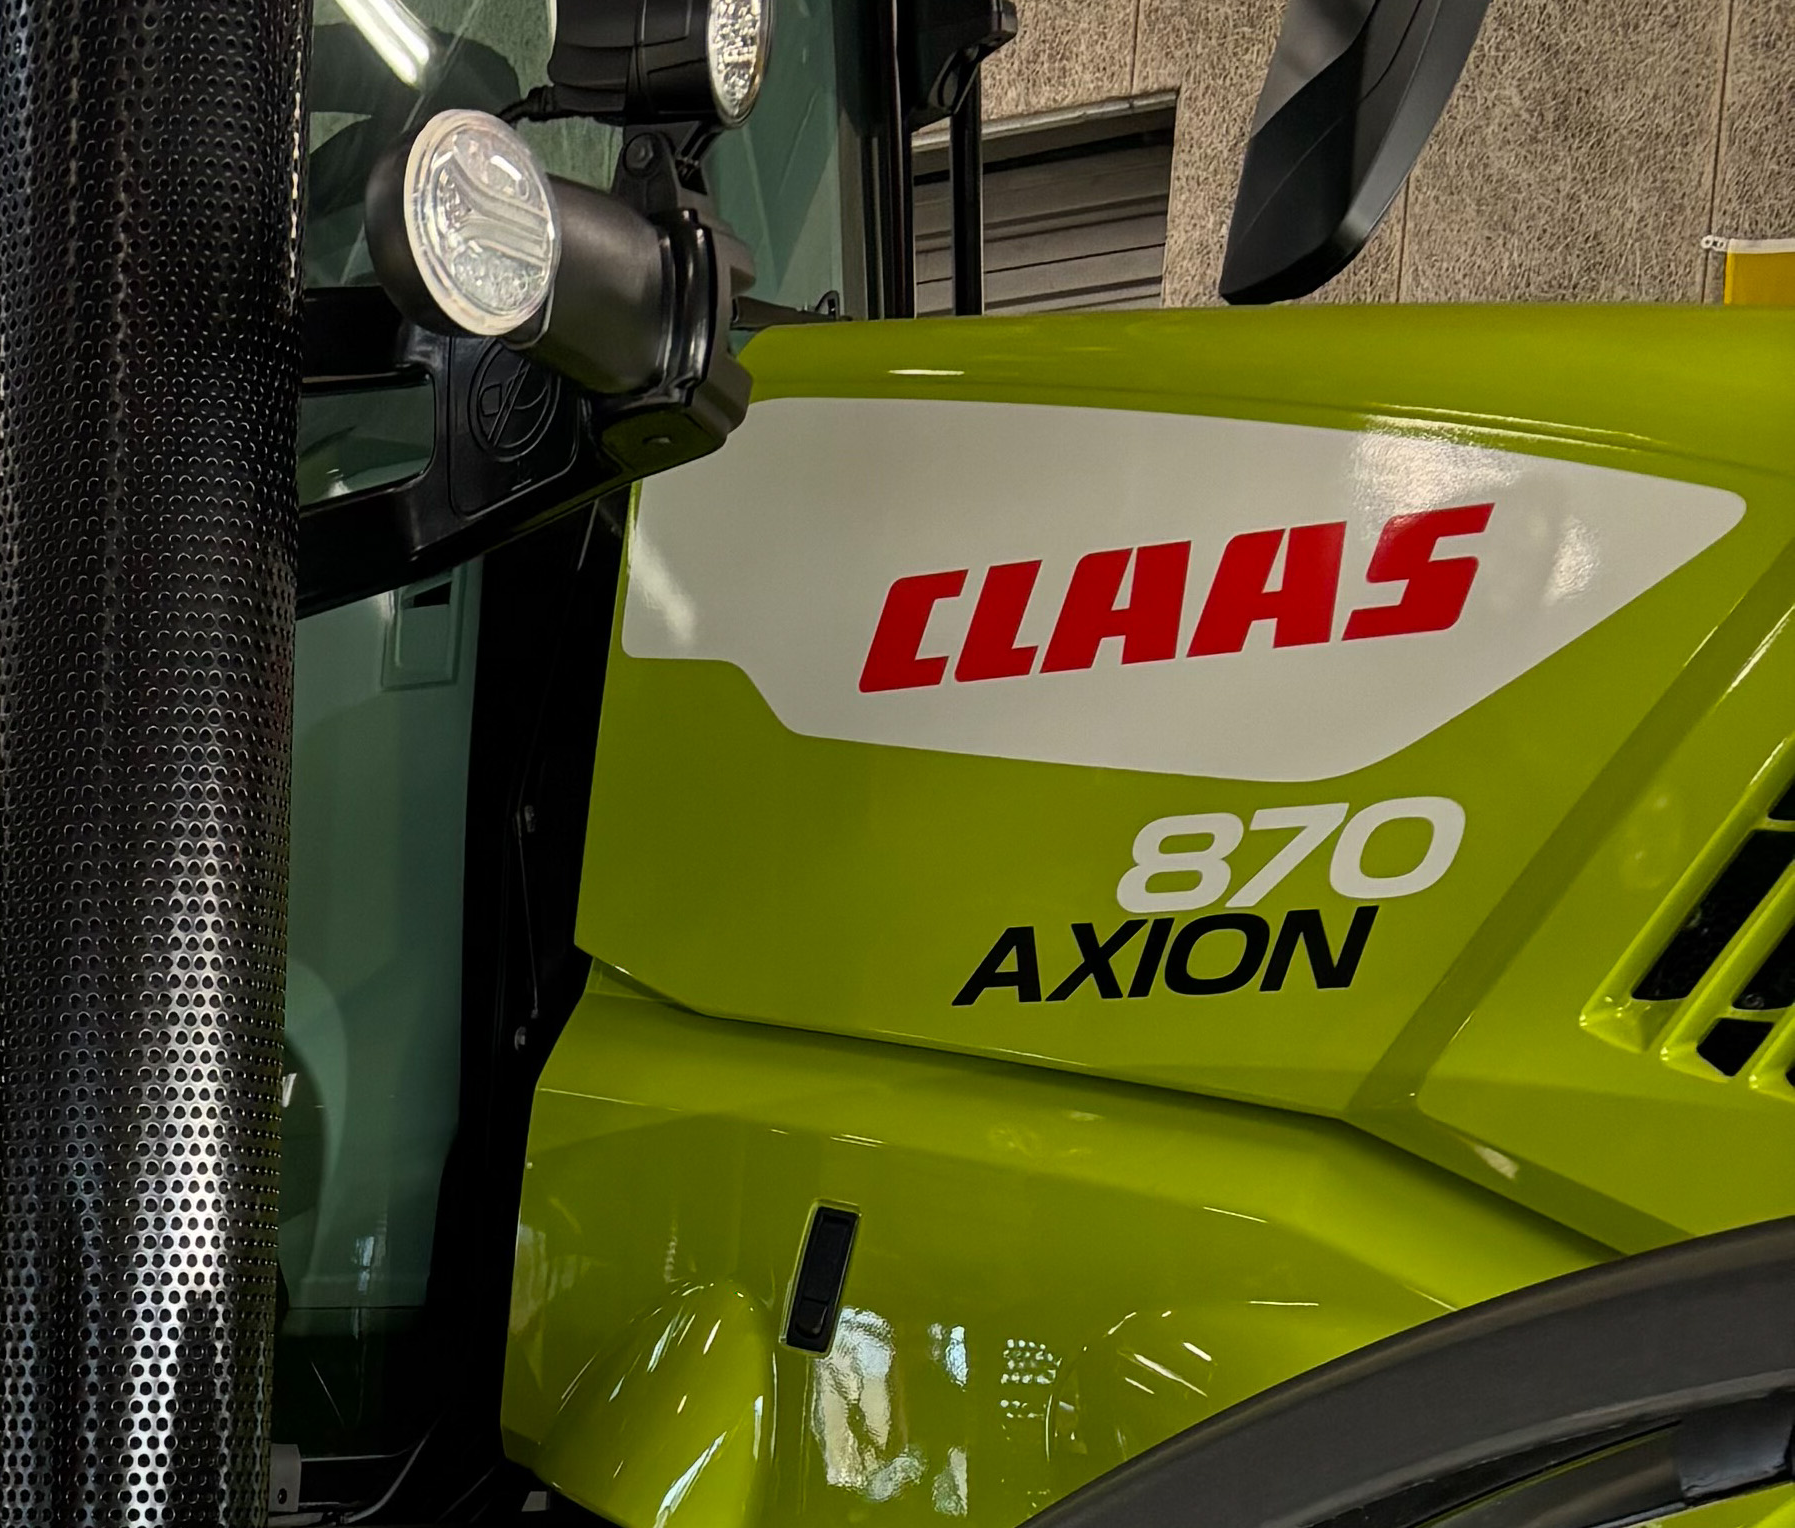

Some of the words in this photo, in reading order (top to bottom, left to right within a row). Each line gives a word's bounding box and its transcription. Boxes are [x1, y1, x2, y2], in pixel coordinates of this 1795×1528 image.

[859, 504, 1493, 692] CLAAS
[1117, 796, 1466, 913] 870
[952, 906, 1379, 1006] AXION
